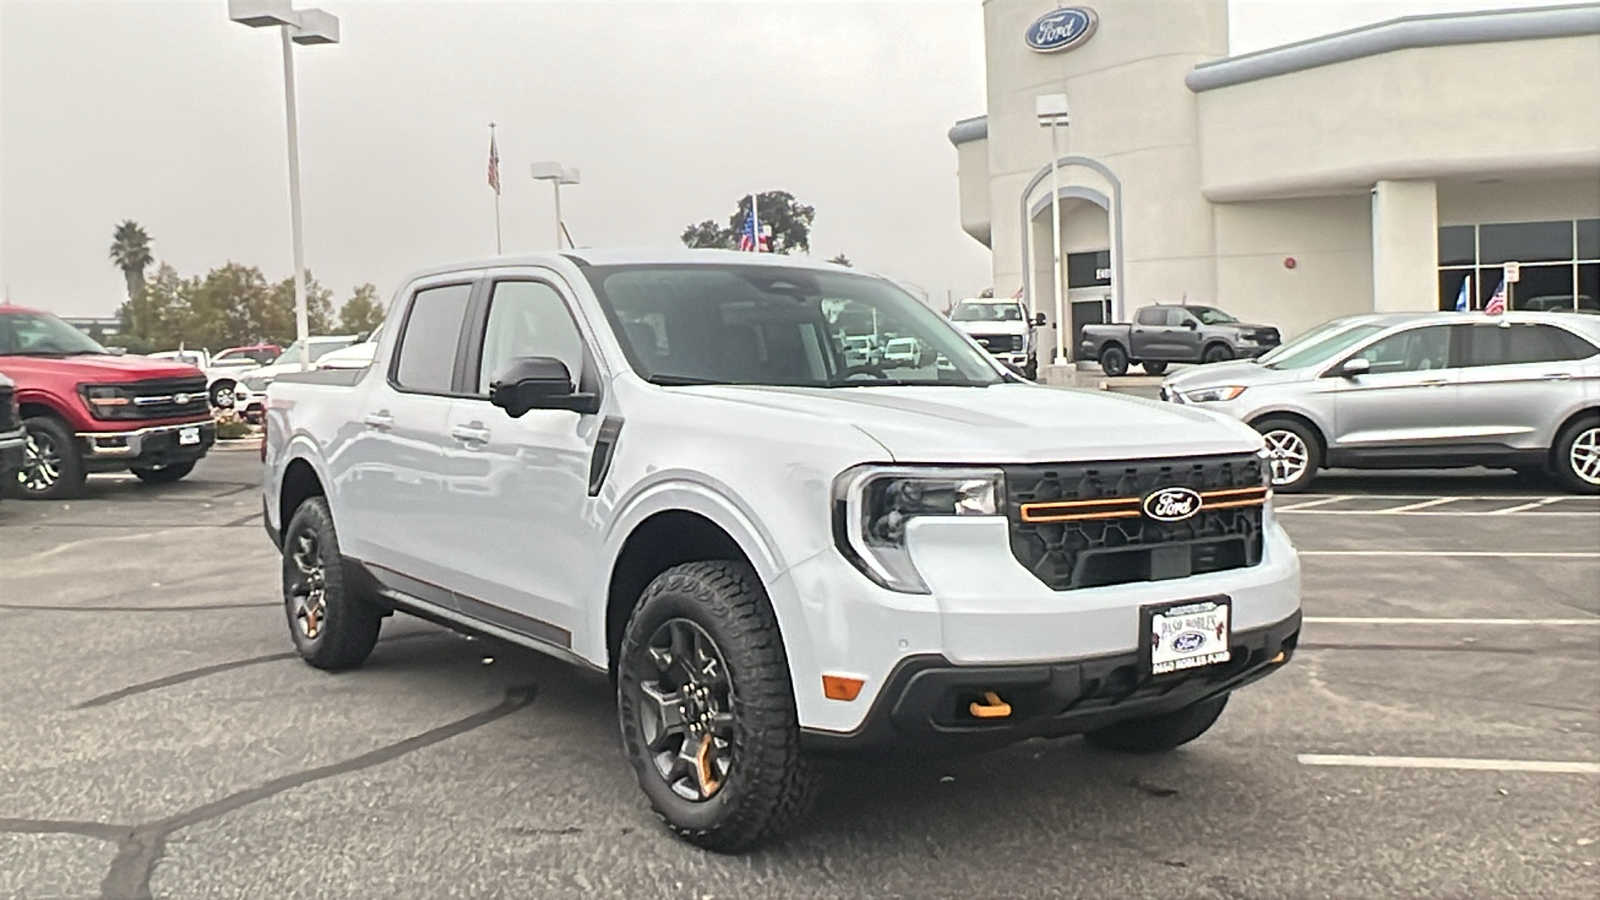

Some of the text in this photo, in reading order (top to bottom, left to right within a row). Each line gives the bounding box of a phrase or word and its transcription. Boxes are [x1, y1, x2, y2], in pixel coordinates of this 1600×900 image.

[1036, 16, 1075, 44] Ford
[1155, 492, 1193, 515] Ford
[1161, 615, 1216, 640] PASO ROBLES
[1176, 635, 1202, 651] Ford
